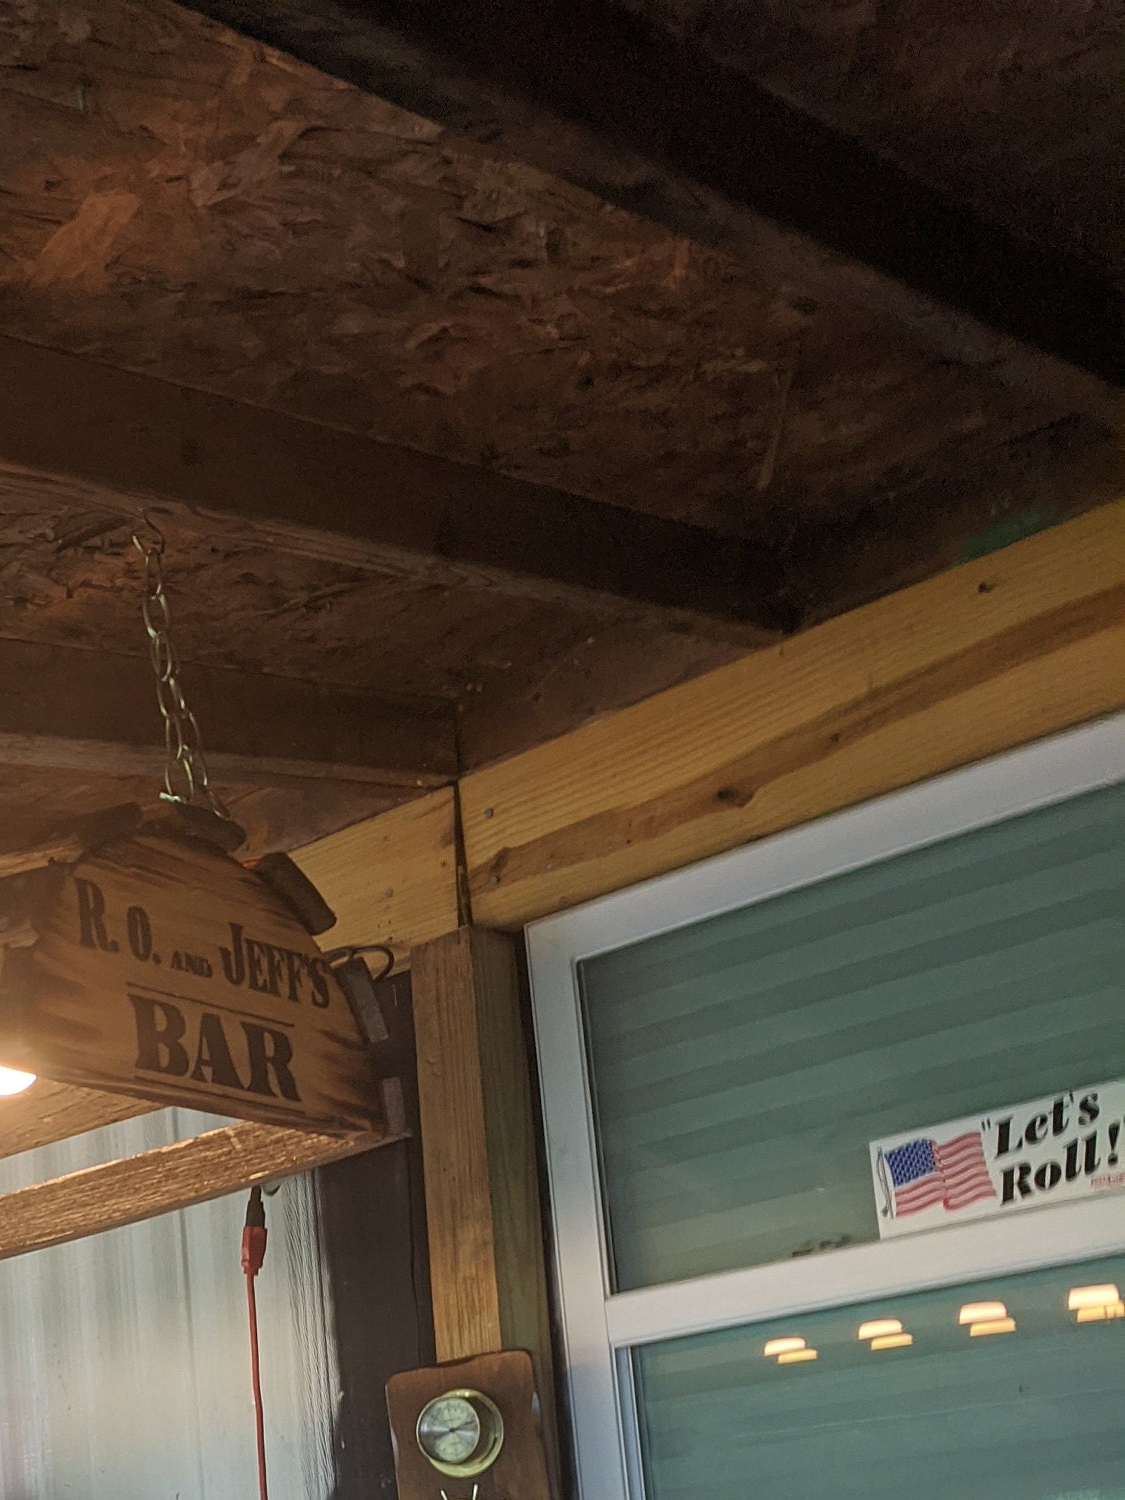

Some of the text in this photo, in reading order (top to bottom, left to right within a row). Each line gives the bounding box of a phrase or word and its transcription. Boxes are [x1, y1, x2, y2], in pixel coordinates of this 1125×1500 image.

[171, 951, 213, 979] AND
[219, 922, 331, 1009] JEFF'S
[127, 993, 302, 1102] BAR
[1000, 1119, 1125, 1206] Roll!
